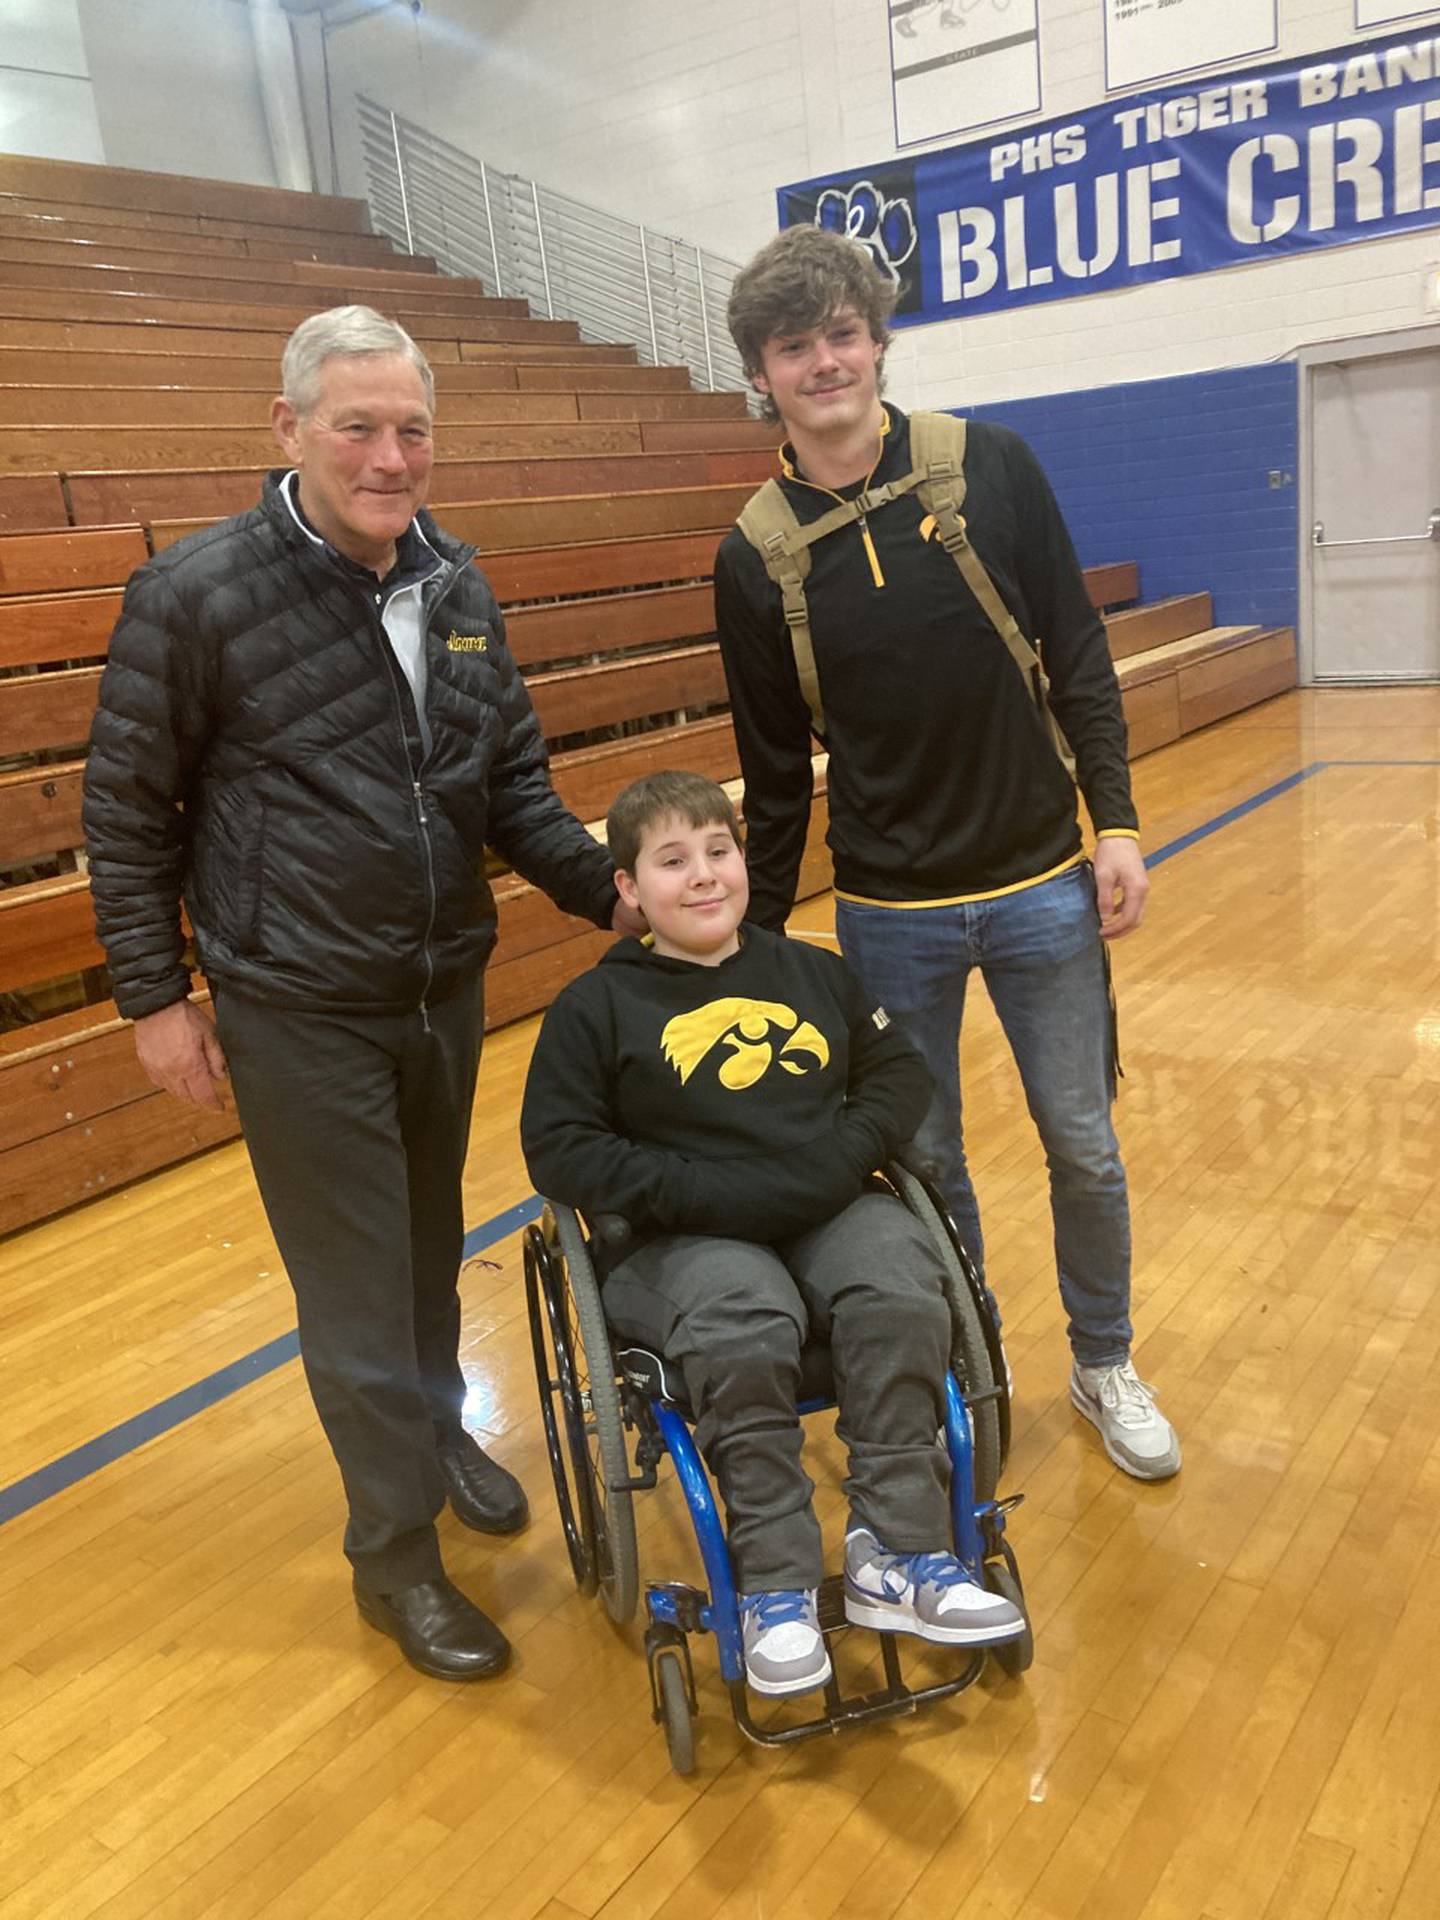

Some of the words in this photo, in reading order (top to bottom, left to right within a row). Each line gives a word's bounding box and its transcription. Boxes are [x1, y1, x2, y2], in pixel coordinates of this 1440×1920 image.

[990, 124, 1087, 182] PHS
[1113, 79, 1269, 149] TIGER
[1301, 38, 1440, 107] BAN
[937, 158, 1182, 303] BLUE
[1227, 98, 1440, 244] CRE
